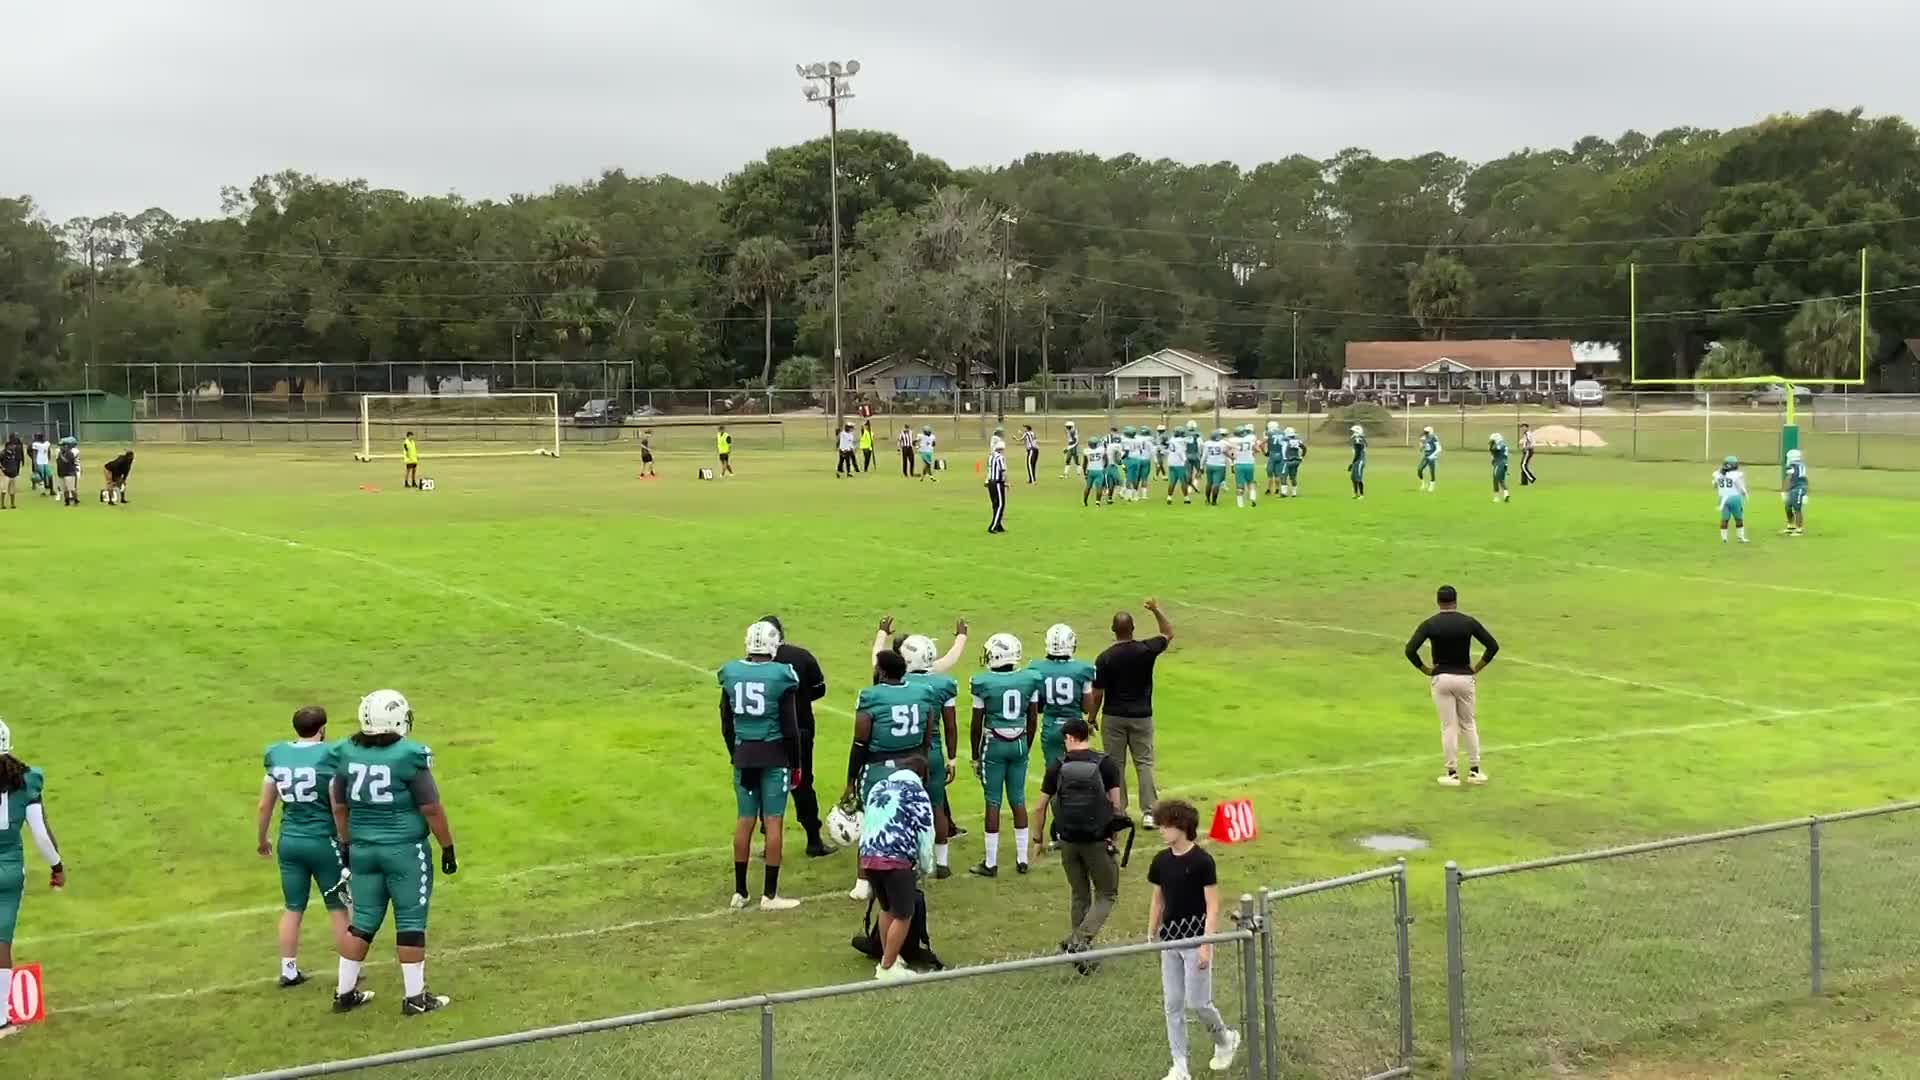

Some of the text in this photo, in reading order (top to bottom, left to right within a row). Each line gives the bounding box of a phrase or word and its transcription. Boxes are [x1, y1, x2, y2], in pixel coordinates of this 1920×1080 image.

[422, 479, 434, 490] 20
[702, 469, 713, 479] 10
[734, 681, 766, 716] 15
[1003, 689, 1021, 720] 0
[1044, 676, 1074, 705] 19
[890, 703, 920, 737] 51
[272, 766, 318, 803] 22
[348, 762, 394, 803] 72
[1223, 801, 1254, 841] 30
[9, 969, 39, 1021] 0
